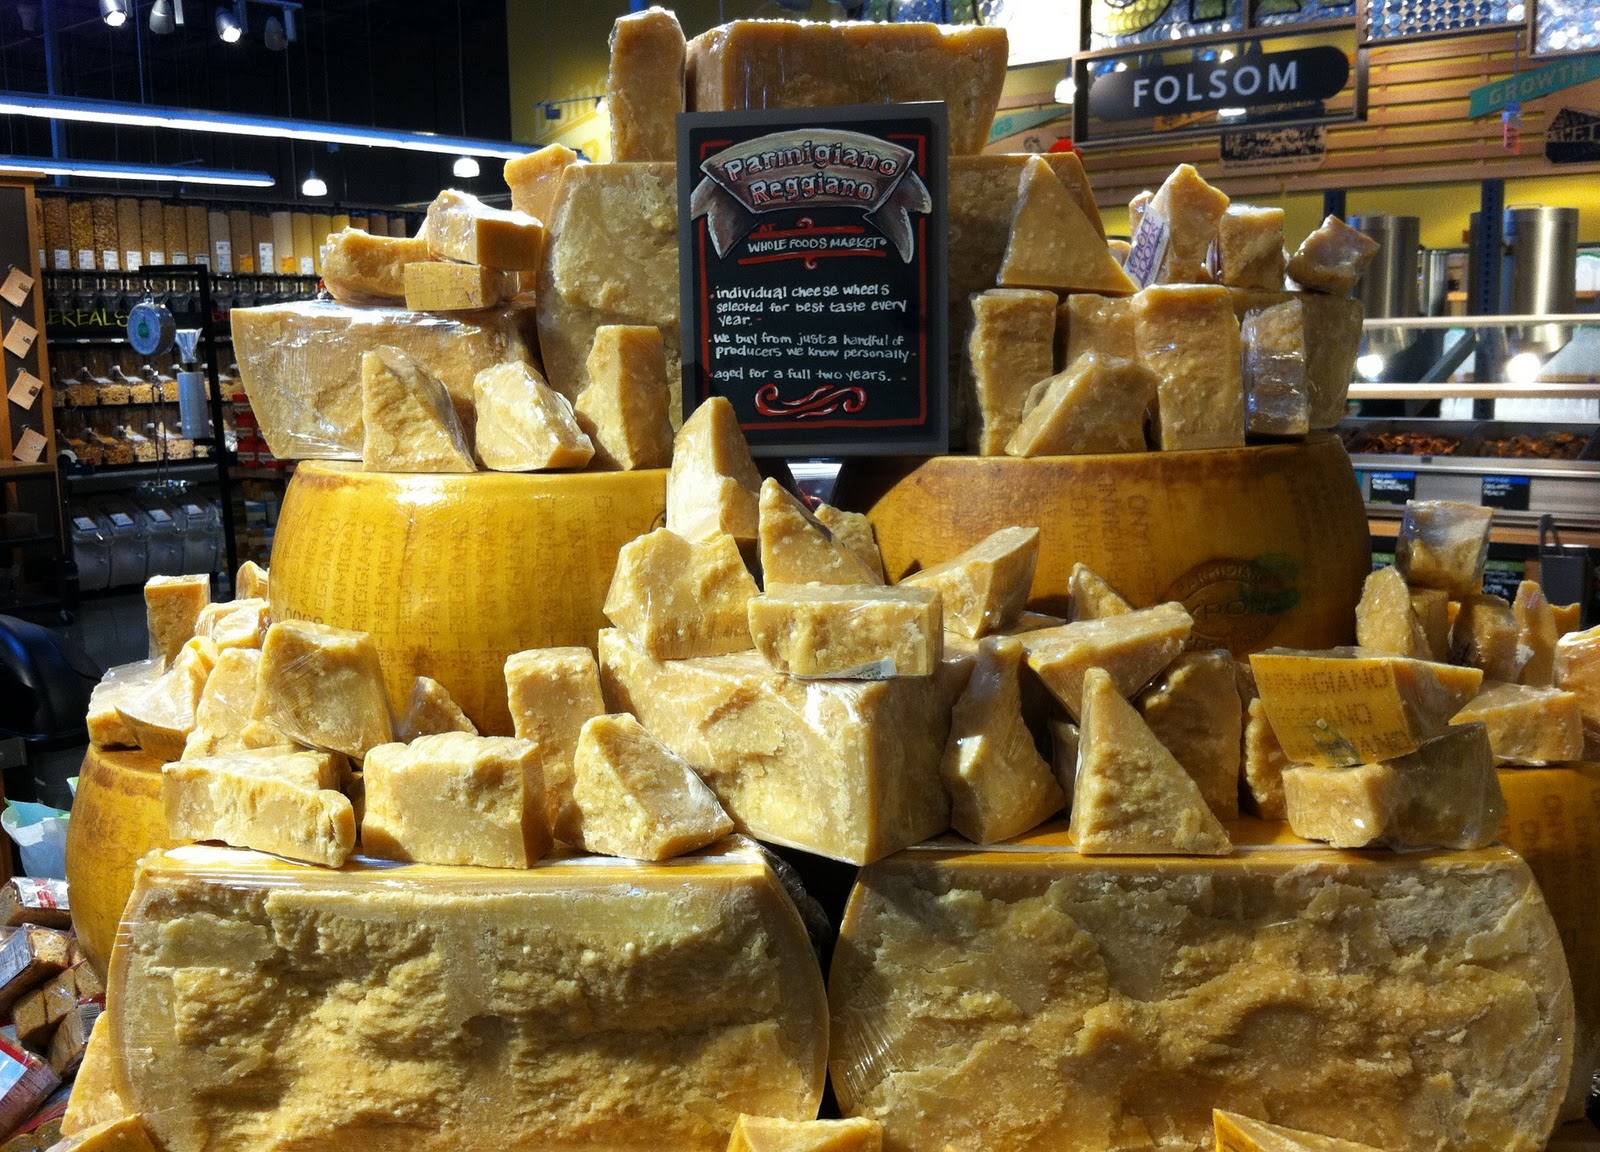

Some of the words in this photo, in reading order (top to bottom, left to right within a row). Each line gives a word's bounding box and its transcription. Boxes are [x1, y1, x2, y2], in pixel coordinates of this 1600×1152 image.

[1133, 60, 1298, 108] FOLSOM
[1489, 58, 1588, 106] GROWTH
[723, 140, 900, 183] Parmigiano
[750, 172, 875, 206] Reggiano
[747, 239, 787, 254] WHOLE
[789, 237, 828, 250] FOODS
[716, 285, 788, 300] individual
[791, 286, 840, 297] cheese
[842, 284, 890, 296] wheels
[716, 302, 764, 313] selected
[769, 301, 790, 313] for
[796, 301, 825, 313] best
[829, 300, 866, 312] taste
[871, 300, 907, 314] every
[718, 315, 753, 327] year.
[735, 333, 758, 346] buy
[761, 332, 792, 344] from
[797, 333, 826, 345] just
[828, 336, 838, 344] a
[843, 333, 889, 347] handful
[891, 335, 905, 347] of
[715, 346, 783, 360] producers
[786, 347, 804, 357] we
[808, 347, 840, 358] know
[843, 349, 910, 364] personally
[714, 368, 745, 382] aged
[748, 368, 770, 380] for
[773, 370, 784, 379] a
[787, 367, 811, 380] full
[816, 369, 843, 380] two
[846, 370, 892, 382] years.
